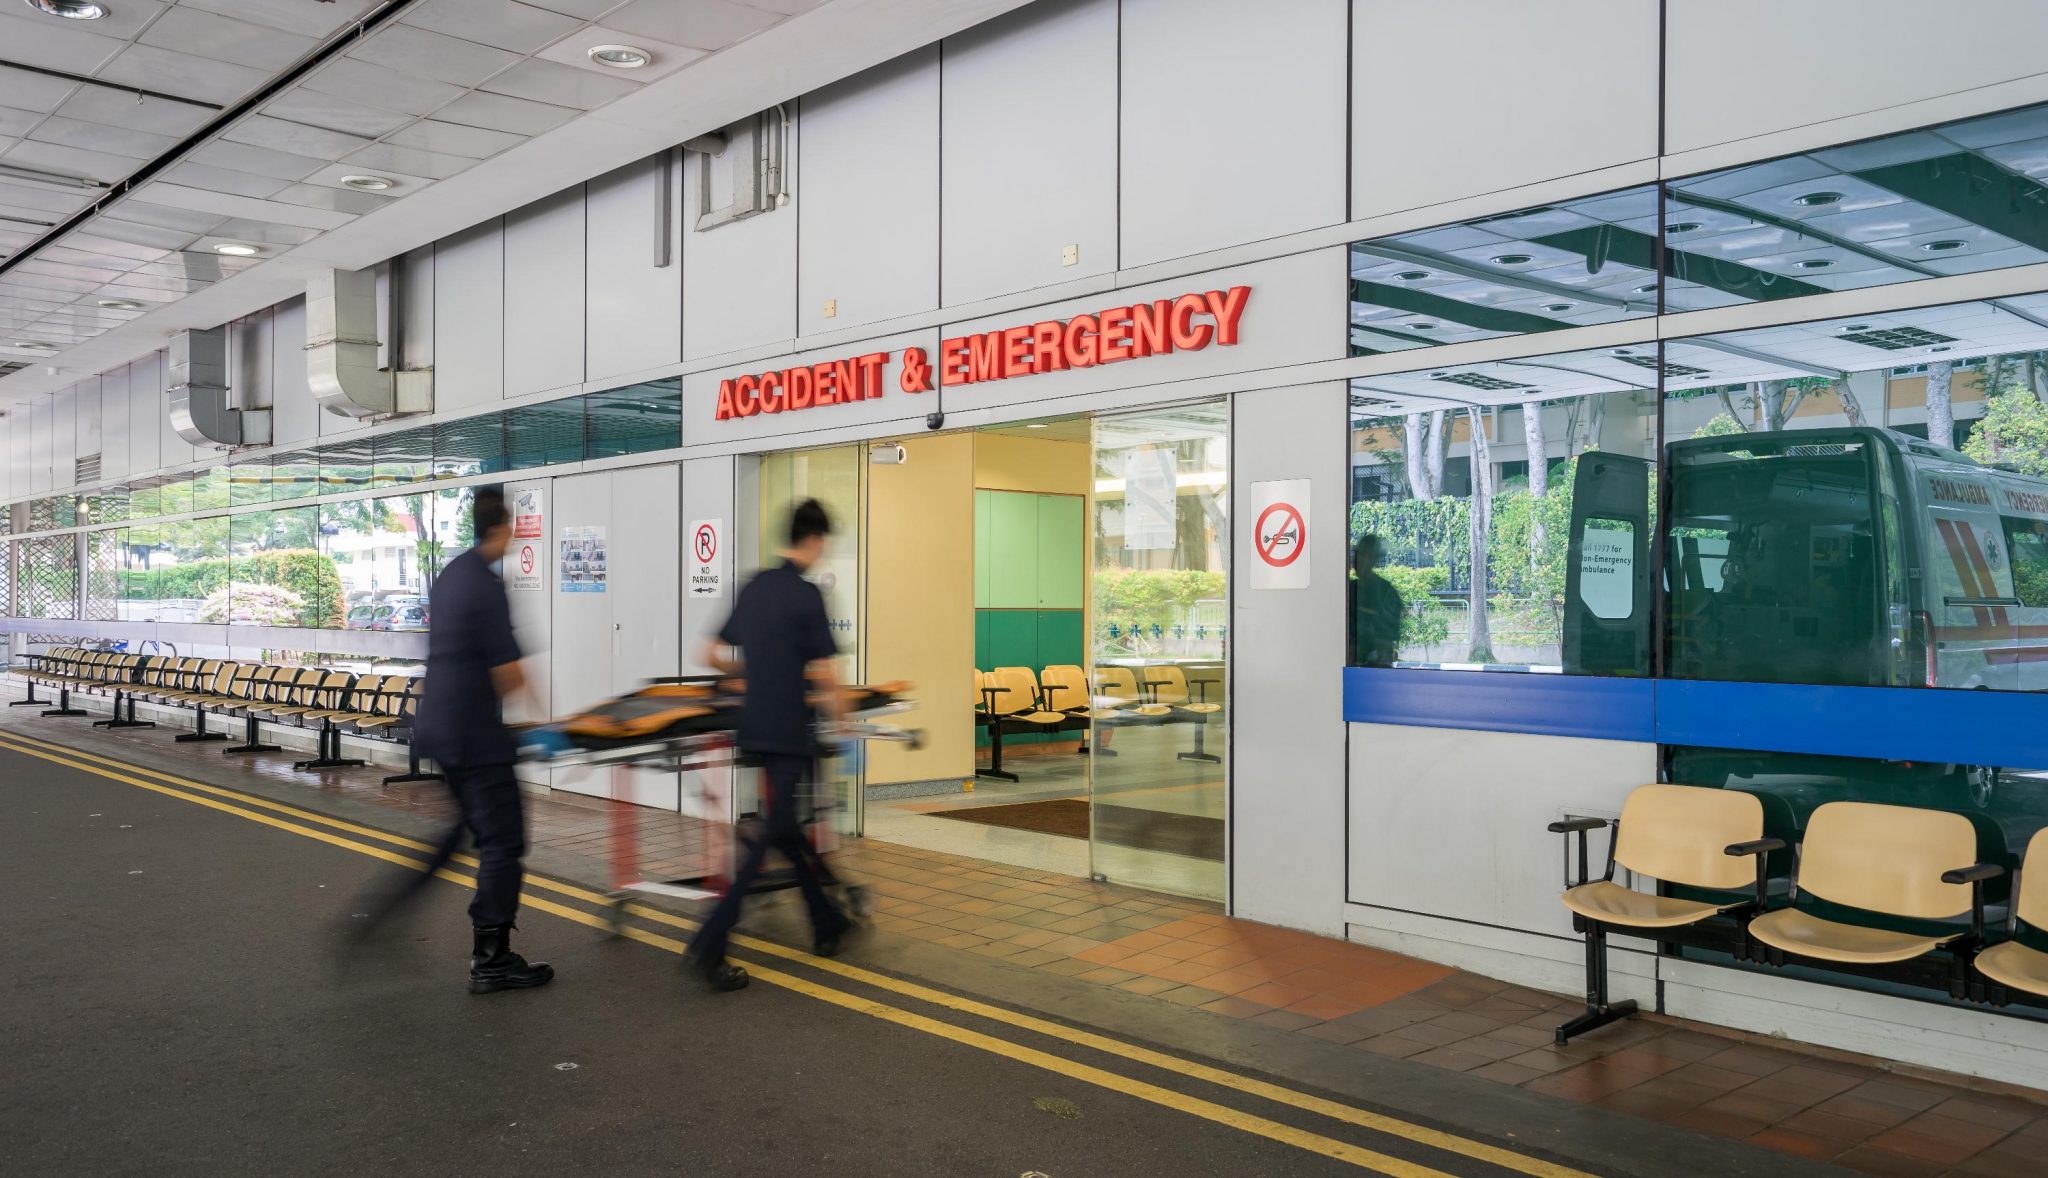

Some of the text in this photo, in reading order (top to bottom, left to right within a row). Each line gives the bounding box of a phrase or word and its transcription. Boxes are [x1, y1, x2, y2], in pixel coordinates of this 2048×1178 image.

[715, 286, 1252, 421] ACCIDENT & EMERGENCY
[1594, 544, 1610, 553] 1777
[1611, 544, 1622, 553] for
[1582, 554, 1632, 566] on-Emergency
[701, 566, 710, 575] NO
[1581, 565, 1615, 574] mbulance
[692, 575, 719, 584] PARKING
